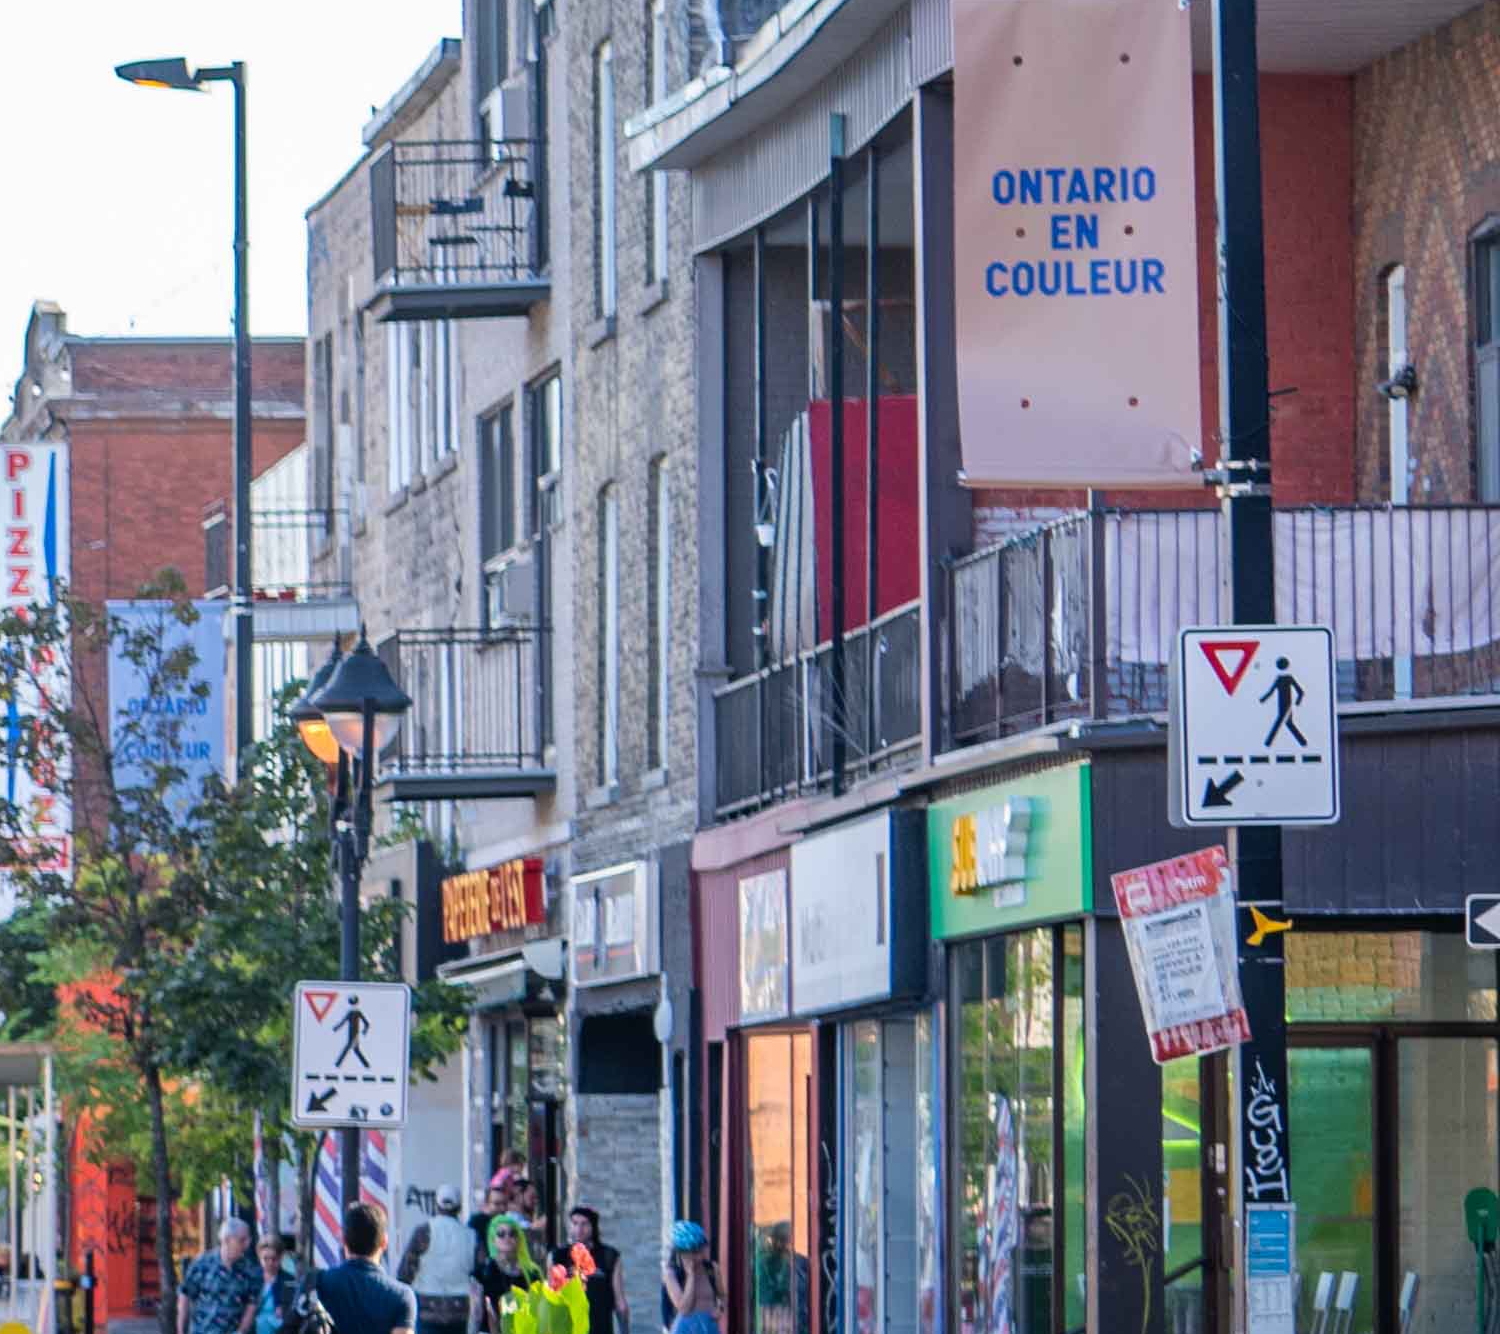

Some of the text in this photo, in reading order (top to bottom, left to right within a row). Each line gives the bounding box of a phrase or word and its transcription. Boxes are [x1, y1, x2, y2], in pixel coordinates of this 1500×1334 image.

[992, 166, 1156, 205] ONTARIO
[1051, 214, 1099, 250] EN
[985, 258, 1166, 298] COULEUR
[6, 450, 31, 623] PIZZ
